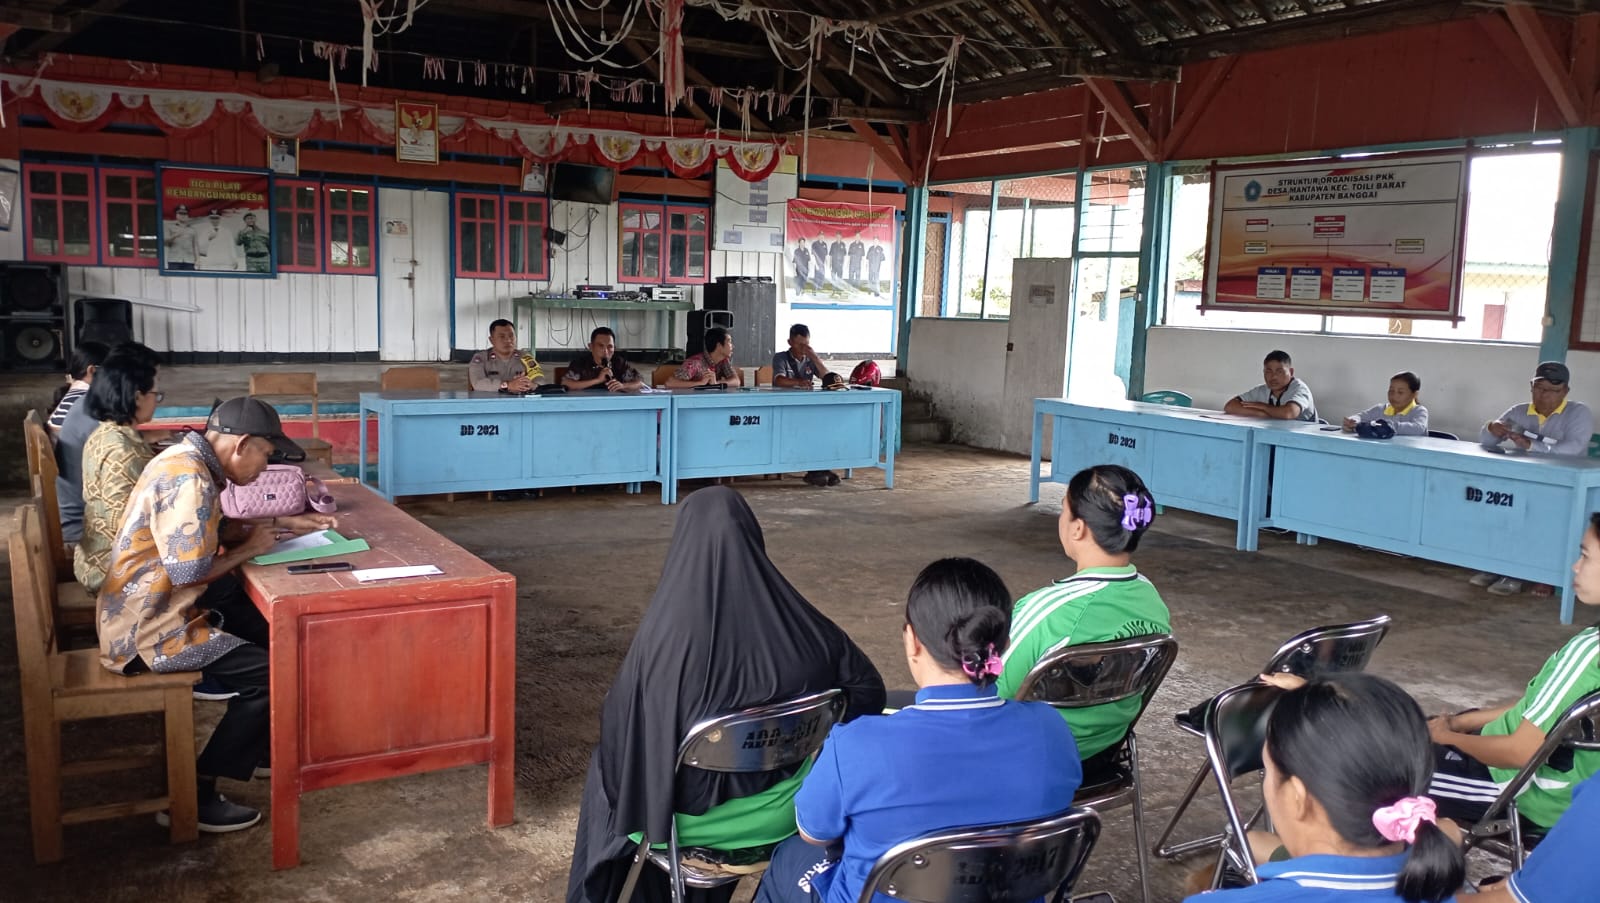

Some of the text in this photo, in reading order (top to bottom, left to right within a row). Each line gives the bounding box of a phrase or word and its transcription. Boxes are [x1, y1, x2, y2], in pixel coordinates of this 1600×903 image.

[1278, 173, 1394, 187] STRUKTUR ORGANISASI PKK
[1267, 187, 1287, 195] DESA
[1289, 185, 1329, 194] MANTAWA
[1352, 183, 1374, 191] TOILI
[1376, 181, 1406, 190] BARAT
[1289, 191, 1378, 202] KABUPATEN BANGGAI
[729, 415, 760, 426] DD 2021
[460, 424, 499, 436] DD 2021
[1109, 433, 1136, 449] DD 2021
[1465, 486, 1514, 507] DD 2021
